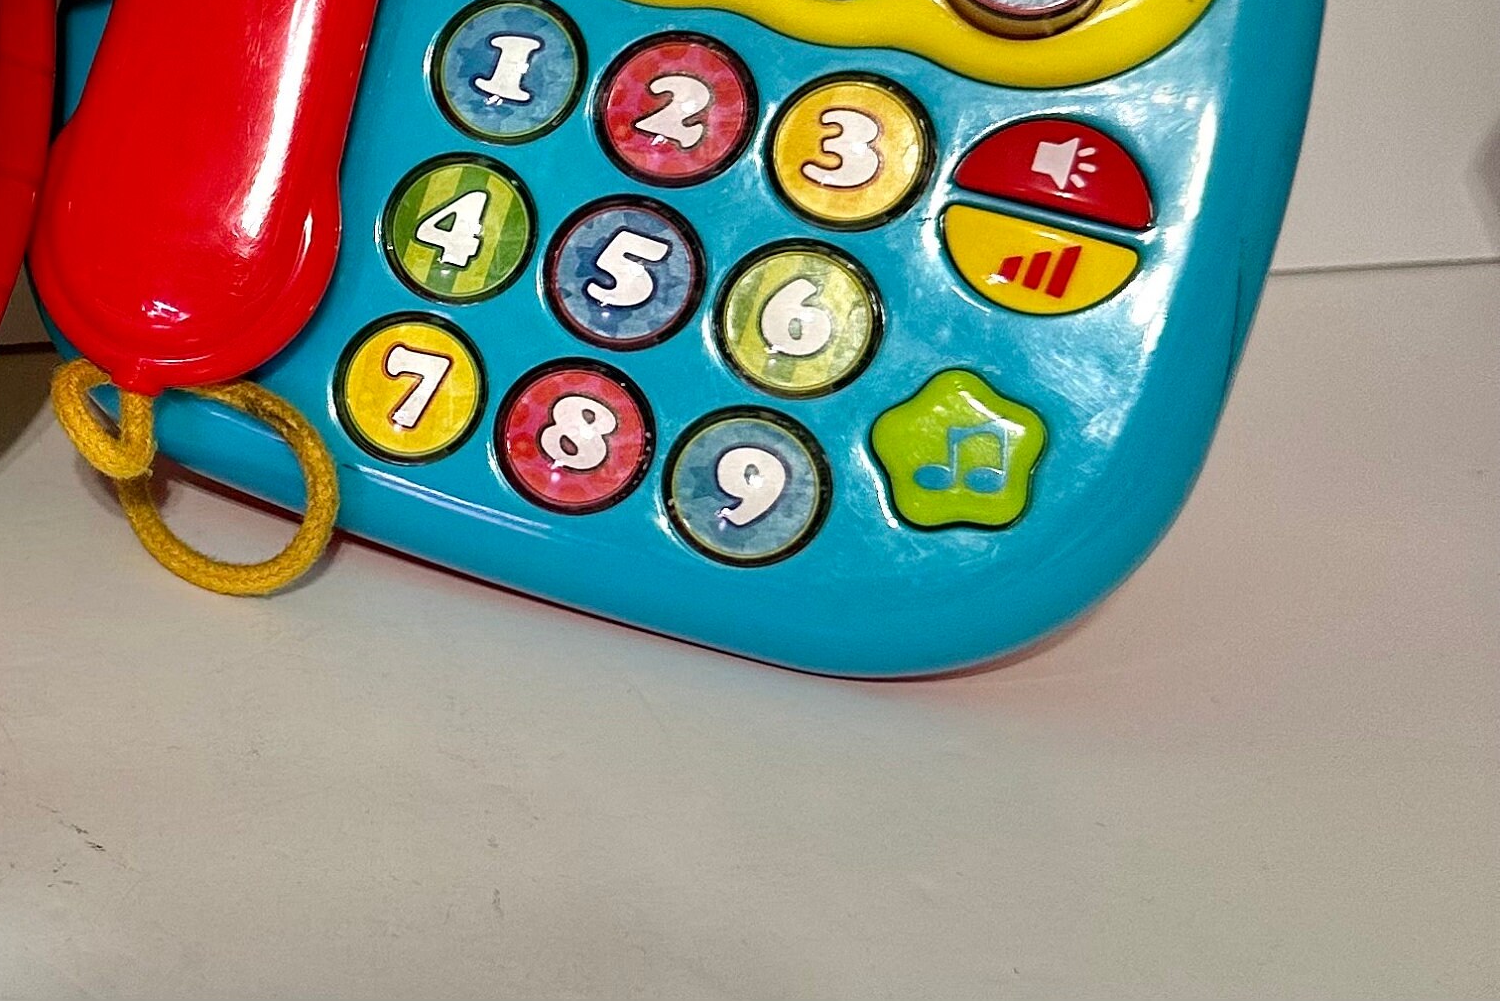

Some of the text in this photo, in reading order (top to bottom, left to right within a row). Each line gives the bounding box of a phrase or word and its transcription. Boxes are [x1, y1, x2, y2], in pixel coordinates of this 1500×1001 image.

[473, 35, 541, 103] 1
[634, 74, 712, 148] 2
[801, 109, 881, 188] 3
[416, 191, 488, 267] 4
[586, 229, 670, 307] 5
[760, 278, 831, 357] 6
[387, 345, 451, 429] 7
[538, 395, 617, 471] 8
[715, 446, 786, 526] 9
